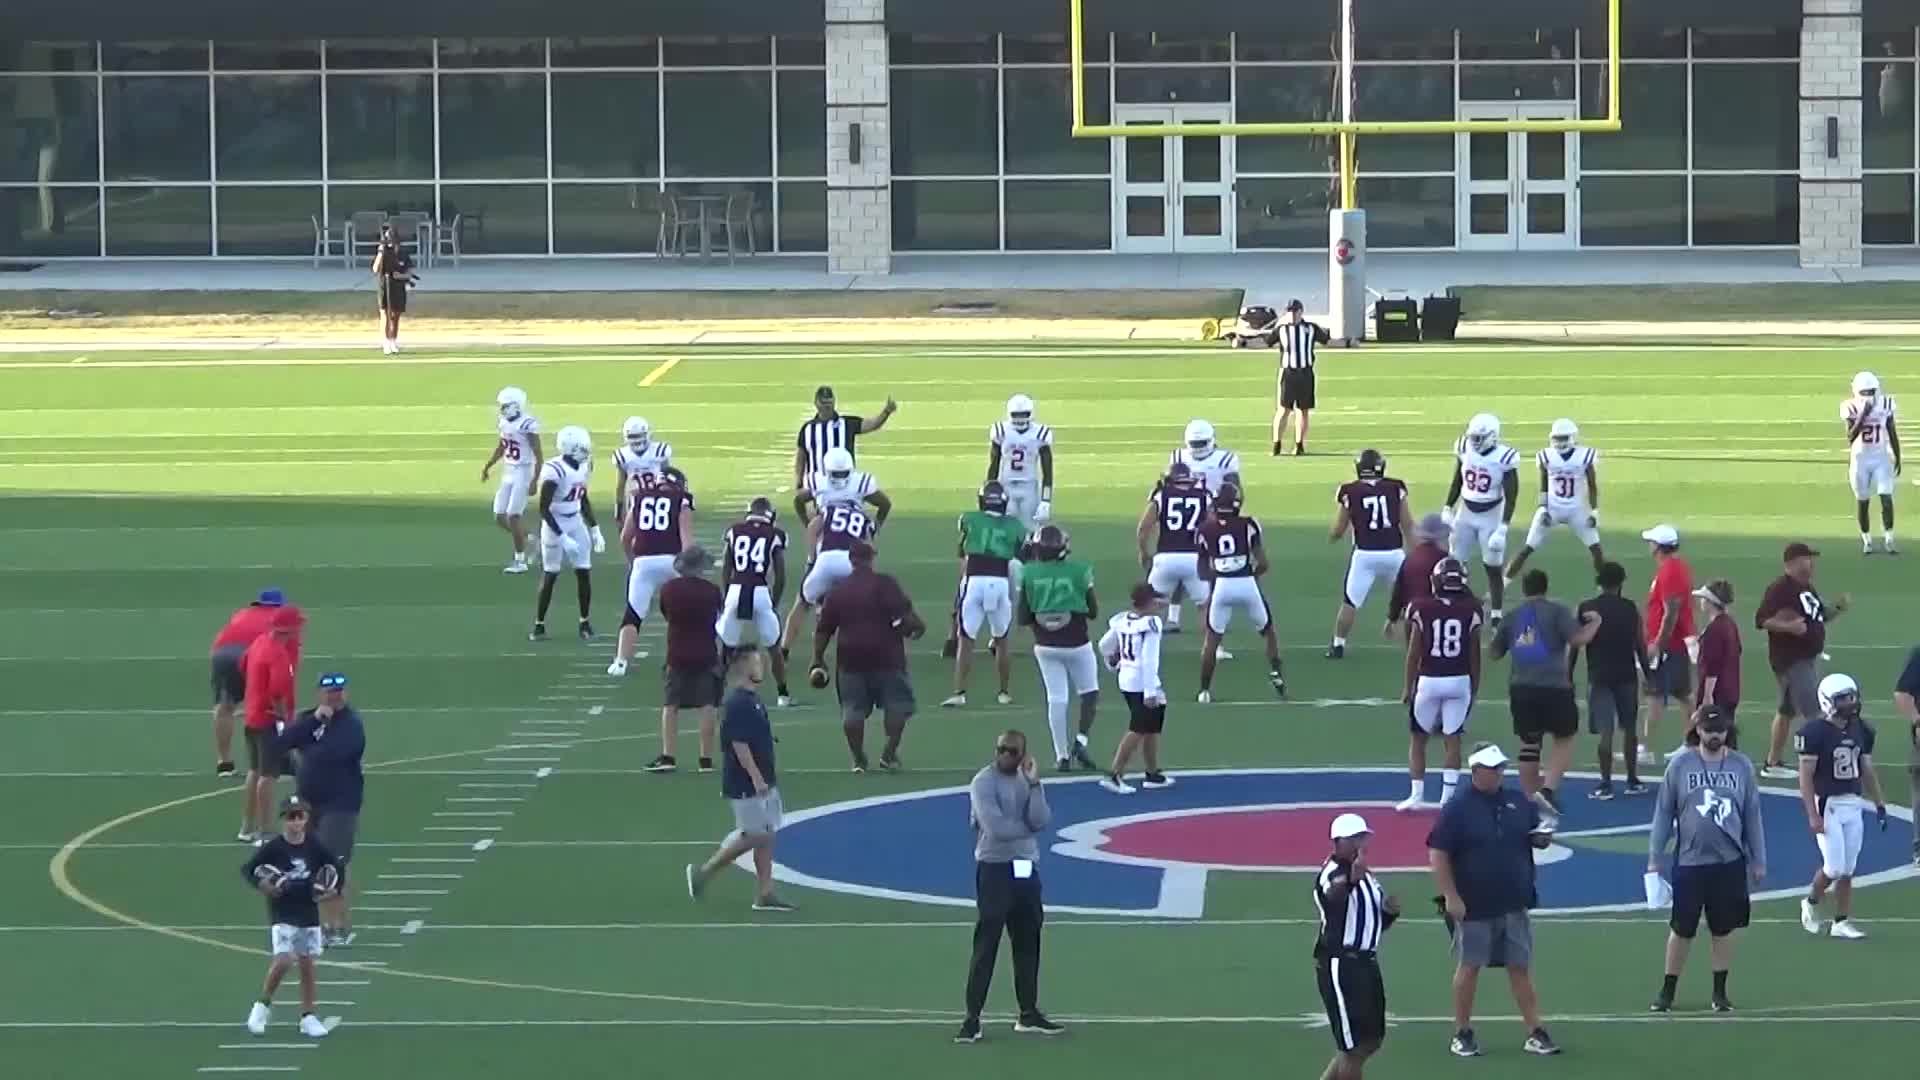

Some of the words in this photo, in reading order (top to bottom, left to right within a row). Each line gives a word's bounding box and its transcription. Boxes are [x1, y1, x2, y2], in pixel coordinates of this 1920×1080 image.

[1010, 449, 1025, 471] 2
[1554, 477, 1576, 499] 31
[638, 497, 671, 531] 68
[830, 507, 865, 538] 58
[1166, 496, 1201, 531] 57
[1362, 495, 1392, 530] 71
[734, 536, 767, 573] 84
[1430, 618, 1462, 658] 18
[1833, 746, 1862, 780] 21
